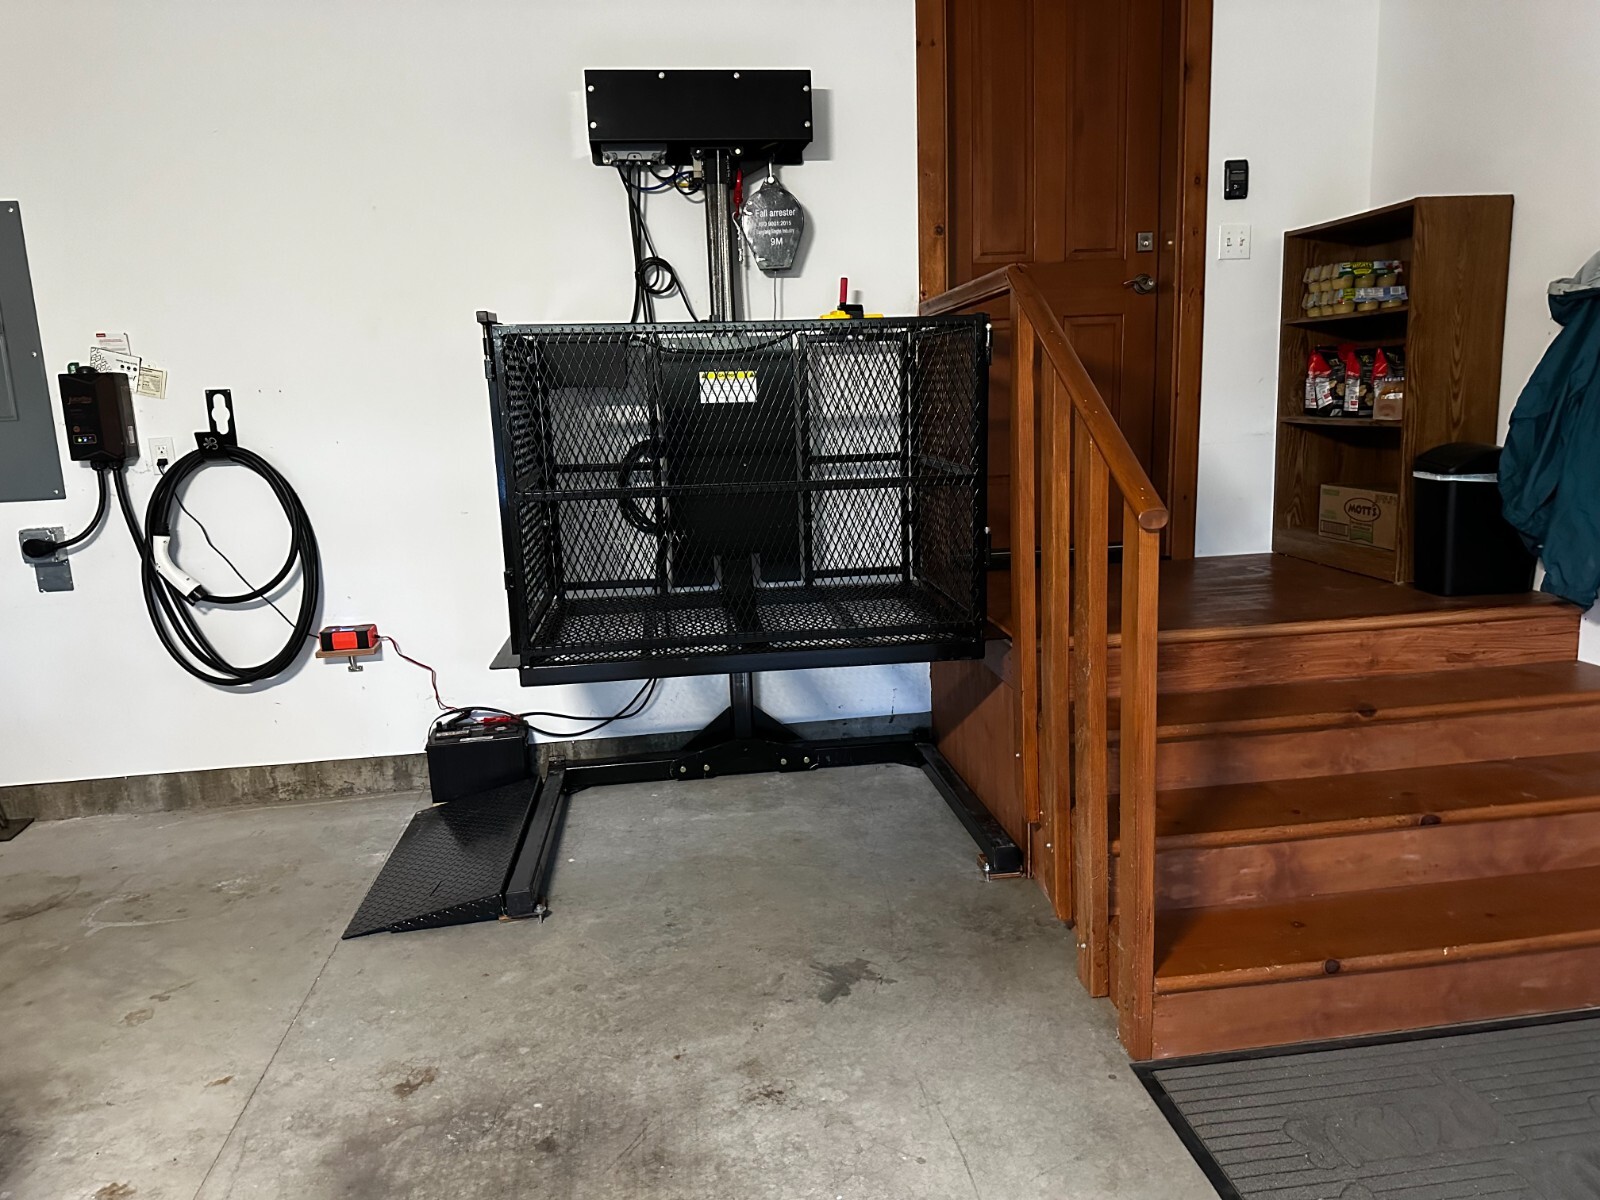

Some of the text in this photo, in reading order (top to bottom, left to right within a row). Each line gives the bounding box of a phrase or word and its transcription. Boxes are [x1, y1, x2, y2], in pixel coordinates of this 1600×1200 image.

[755, 209, 796, 217] Fall arrester
[770, 237, 783, 246] 9M
